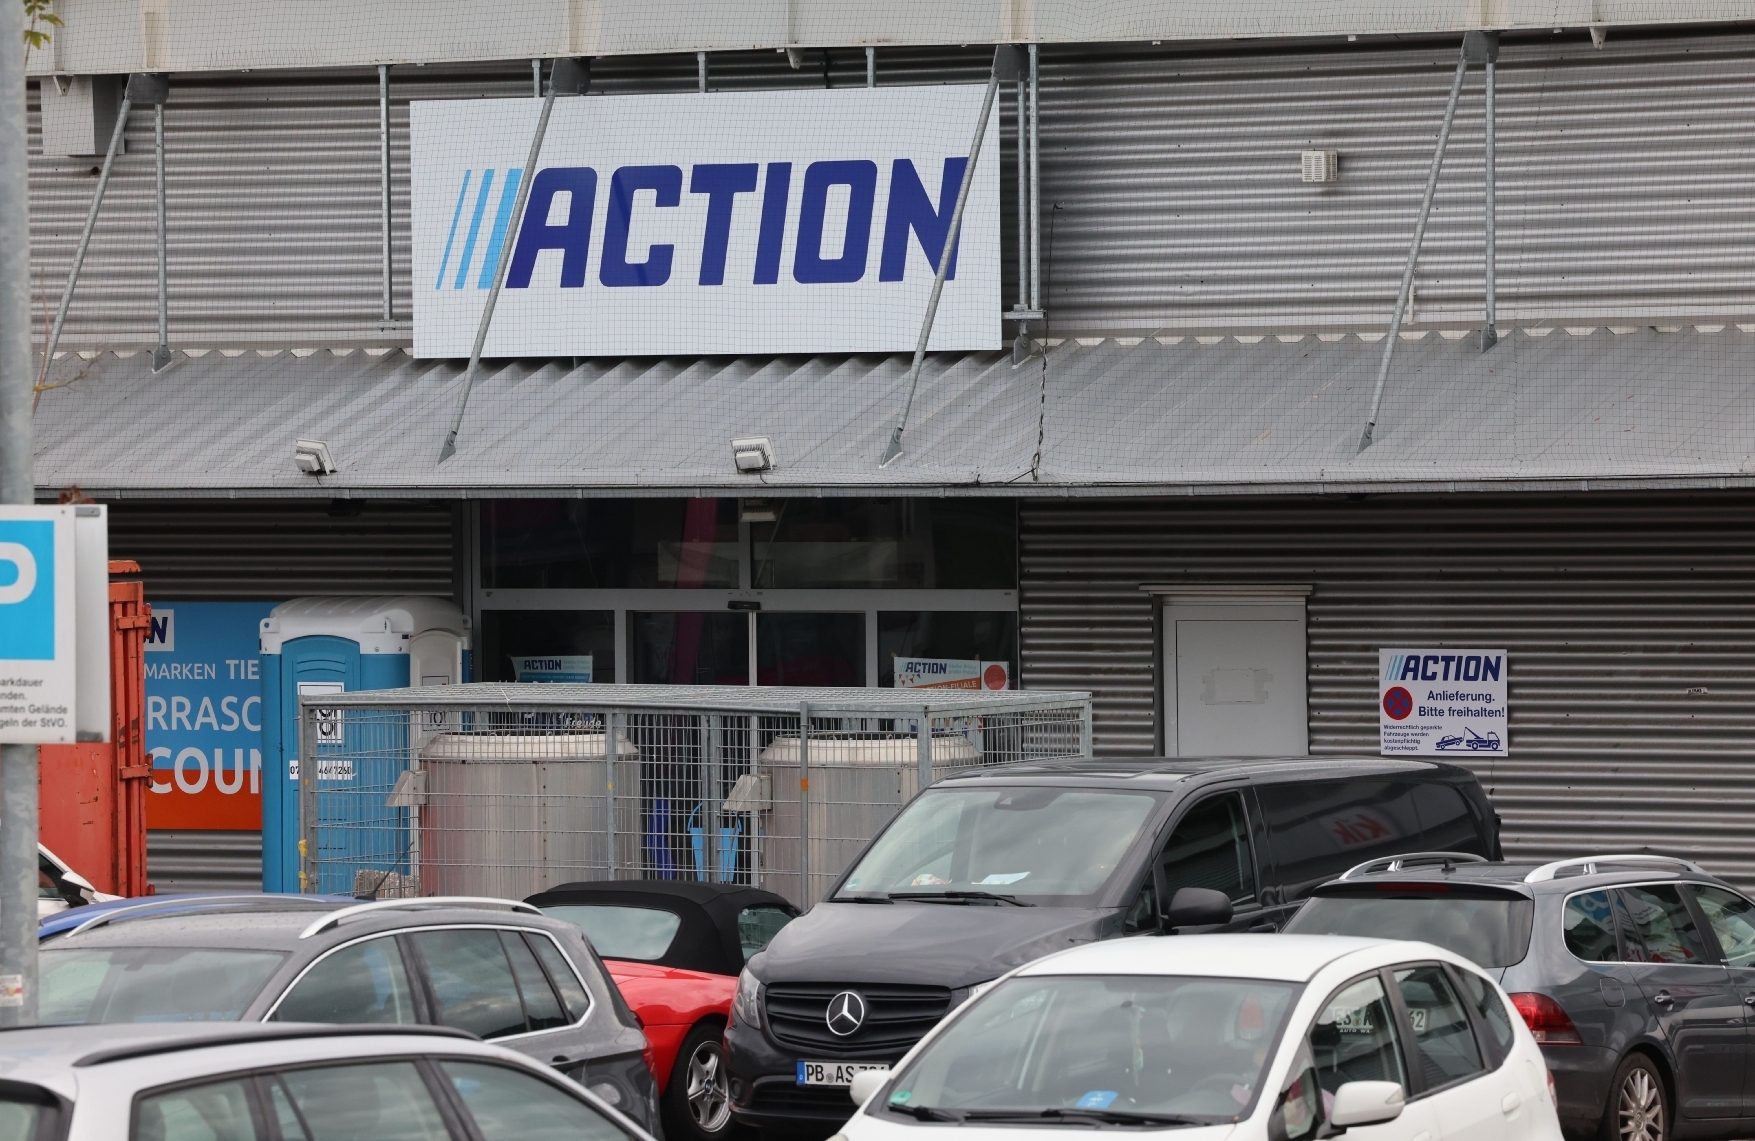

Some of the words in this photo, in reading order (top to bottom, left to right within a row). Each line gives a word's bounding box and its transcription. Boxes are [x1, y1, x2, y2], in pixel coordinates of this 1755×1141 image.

[505, 157, 969, 288] ACTION
[143, 616, 168, 643] N
[144, 663, 216, 680] MARKEN
[225, 660, 260, 680] TIE
[524, 660, 561, 670] ACTION
[905, 662, 947, 674] ACTION
[1400, 655, 1501, 681] ACTION
[0, 677, 43, 687] arkdauer
[1427, 690, 1495, 704] Anlieferung.
[28, 704, 68, 714] Gelände
[1418, 706, 1445, 717] Bitte
[1448, 706, 1505, 717] freihalten!
[21, 718, 37, 727] der
[40, 718, 68, 728] StVO.
[806, 1064, 824, 1082] PB
